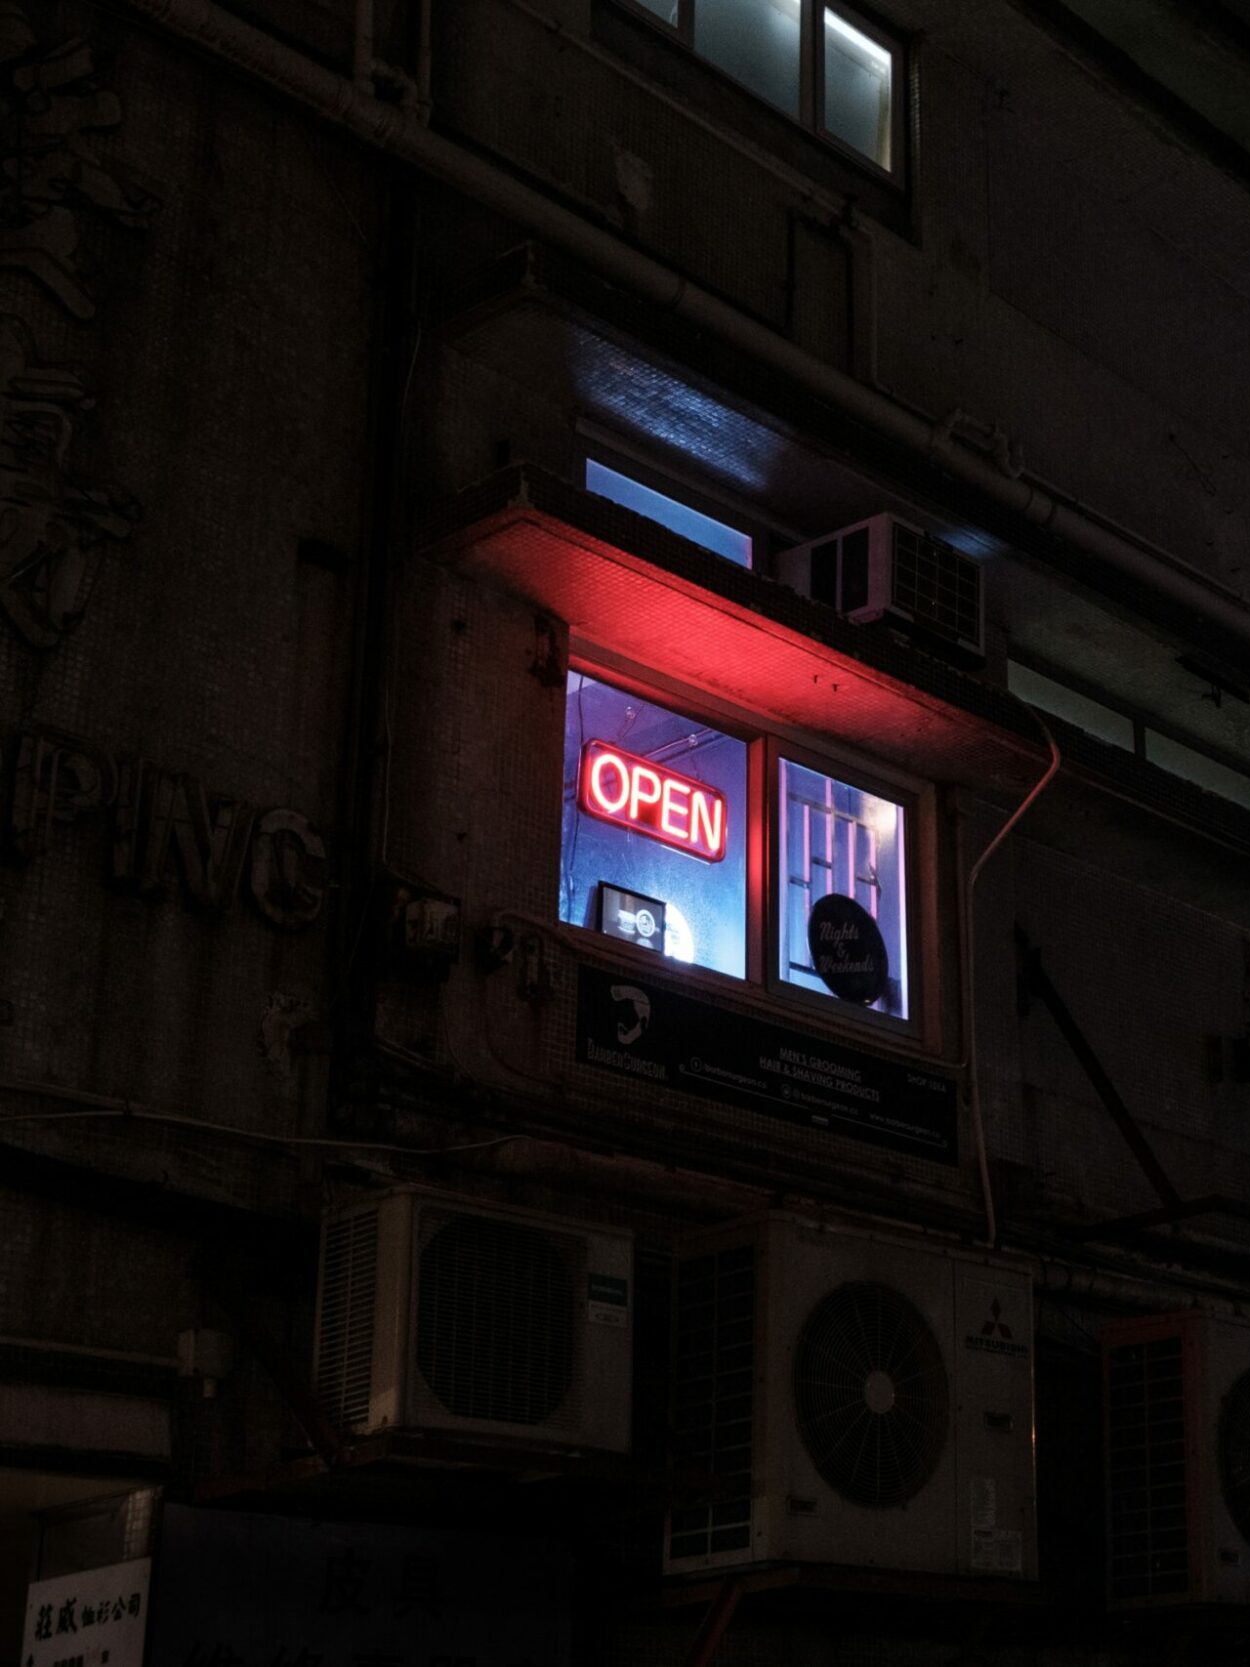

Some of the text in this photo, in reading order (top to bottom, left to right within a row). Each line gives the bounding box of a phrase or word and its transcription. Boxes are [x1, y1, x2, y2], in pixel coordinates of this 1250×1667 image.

[591, 753, 722, 851] OPEN
[819, 921, 859, 948] Nights
[836, 941, 846, 958] &
[818, 954, 875, 974] Weekends
[759, 1056, 782, 1073] HAIR
[791, 1066, 834, 1088] SHAVING
[834, 1077, 881, 1103] PRODUCTS
[779, 1047, 863, 1083] MEN'S GROOMING
[965, 1335, 1029, 1354] MITSUBISHI
[318, 1550, 445, 1619] 皮具
